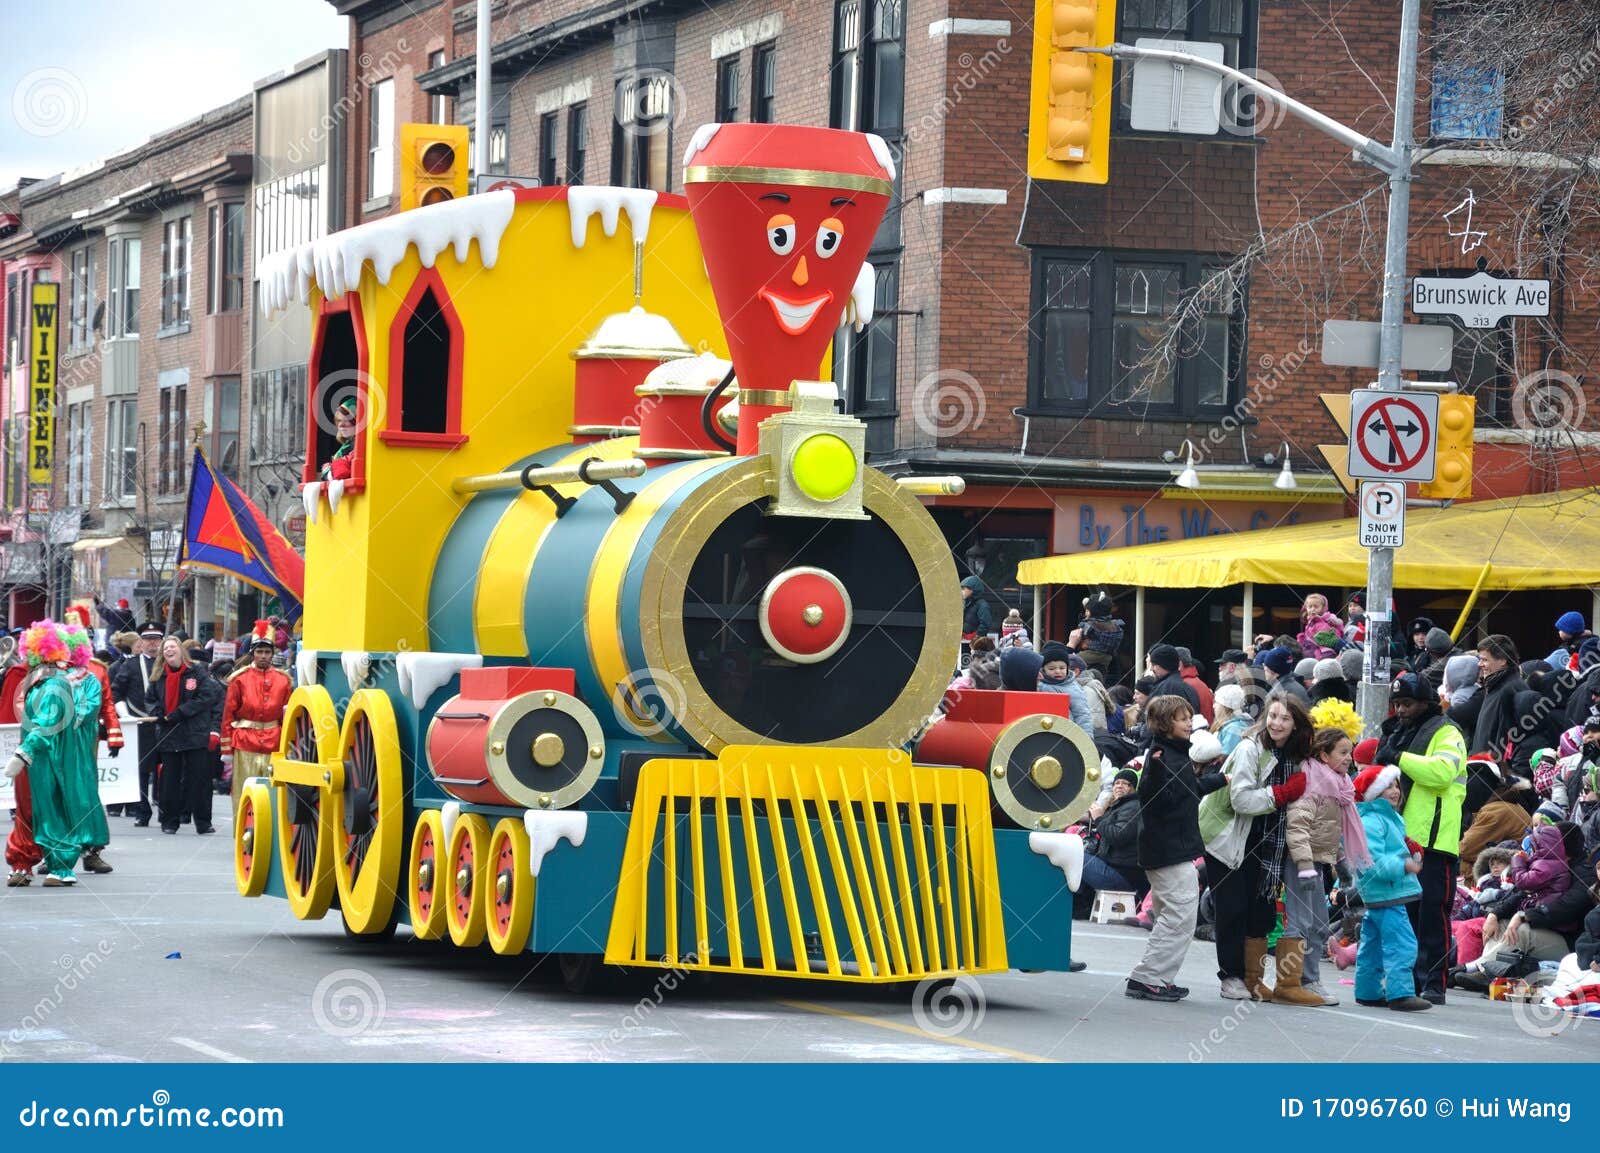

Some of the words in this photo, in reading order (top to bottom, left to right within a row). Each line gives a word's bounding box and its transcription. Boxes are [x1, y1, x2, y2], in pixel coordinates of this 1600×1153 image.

[1416, 284, 1506, 305] Brunswick
[1515, 286, 1547, 305] Ave
[1473, 318, 1489, 326] 313
[33, 304, 56, 470] WIENER
[1080, 504, 1111, 550] By
[1367, 523, 1397, 533] SNOW
[1365, 535, 1398, 545] ROUTE
